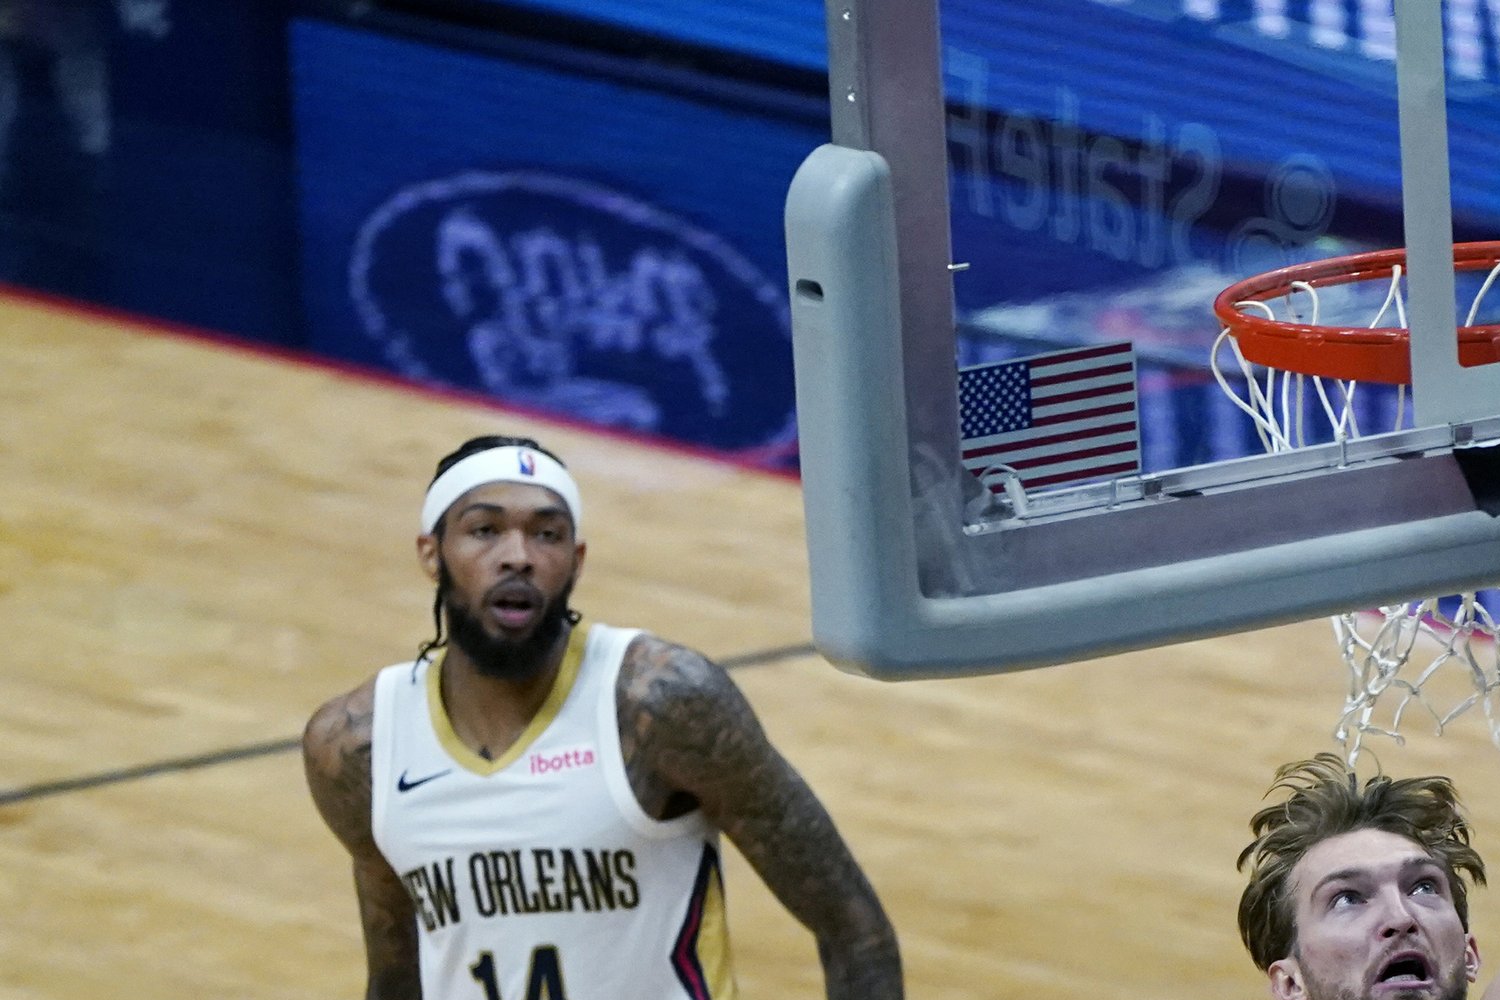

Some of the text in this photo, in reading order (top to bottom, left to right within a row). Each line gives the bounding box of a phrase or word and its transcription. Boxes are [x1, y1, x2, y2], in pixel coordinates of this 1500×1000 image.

[530, 750, 595, 775] ibotta
[401, 848, 640, 932] EW ORLEANS
